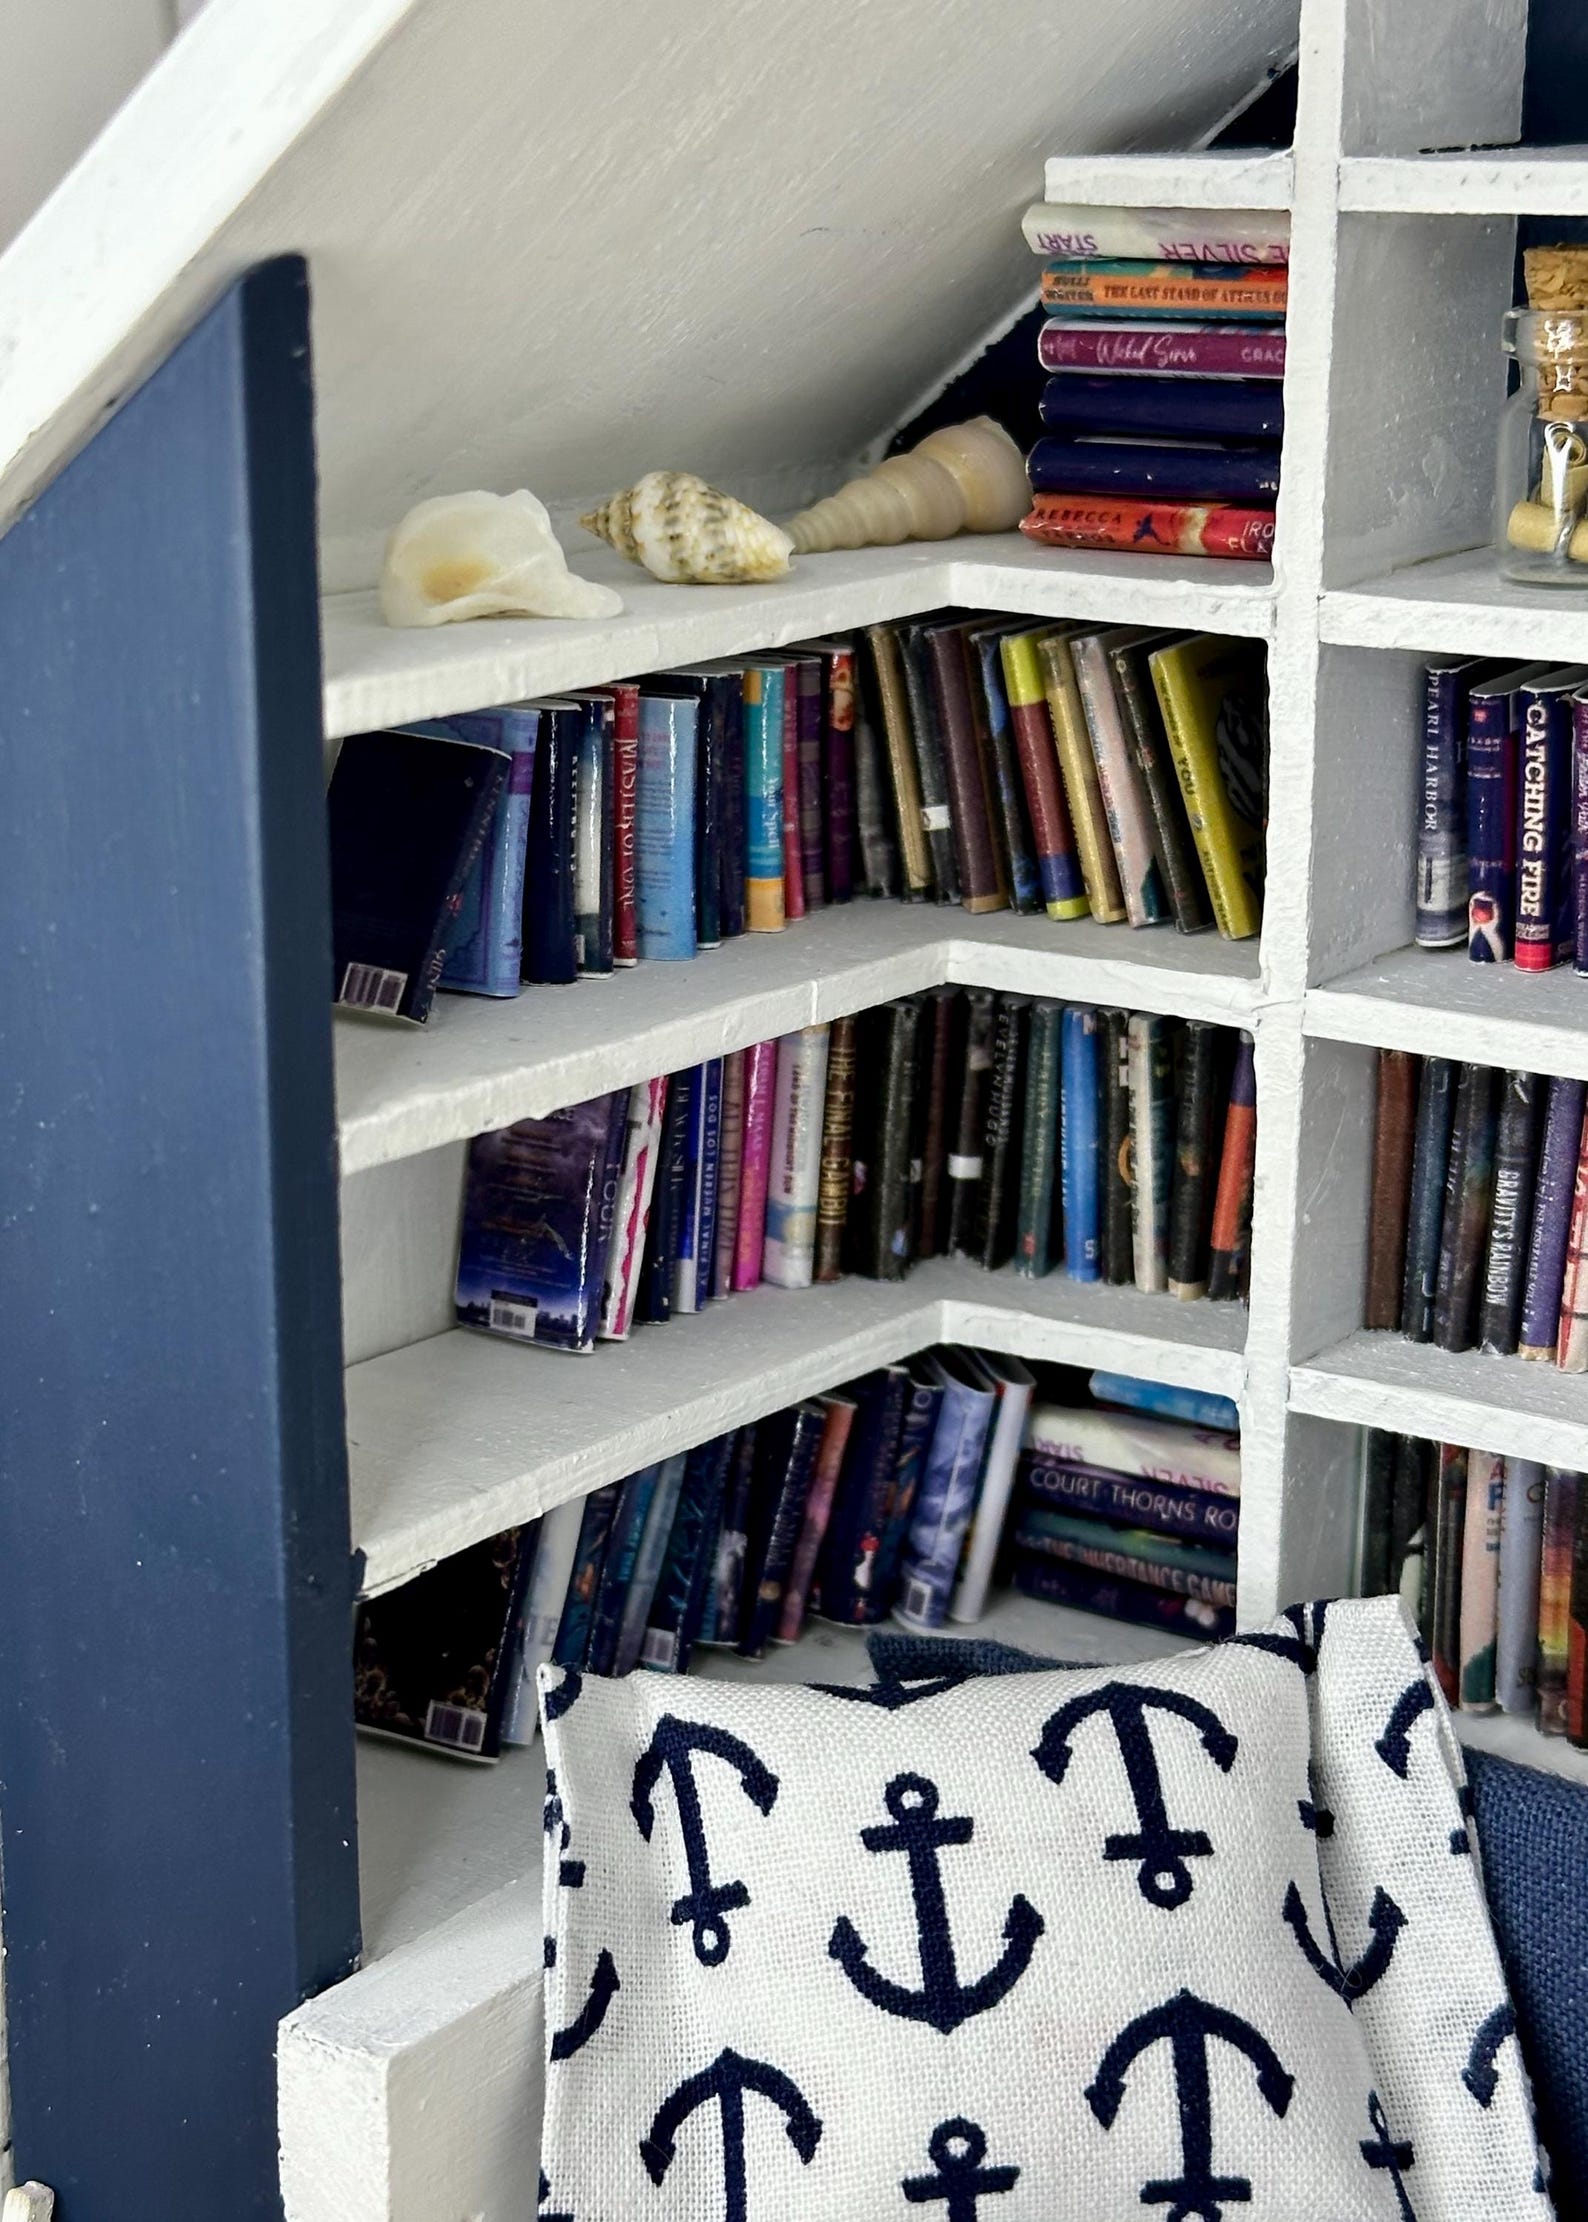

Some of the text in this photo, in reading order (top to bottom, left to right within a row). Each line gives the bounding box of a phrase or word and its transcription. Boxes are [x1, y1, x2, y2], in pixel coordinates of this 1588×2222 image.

[1104, 285, 1129, 299] THE
[1130, 286, 1159, 300] LAST
[1161, 286, 1200, 301] STAND
[1034, 508, 1123, 525] REBECCA
[1174, 756, 1199, 796] YOU
[1424, 675, 1440, 830] PEARL HARBOR
[1522, 704, 1546, 852] CATCHING
[615, 738, 639, 829] MASTER
[767, 812, 781, 848] Spell
[1520, 858, 1544, 917] FIRE
[708, 1094, 719, 1124] DOS
[825, 1090, 856, 1147] FINAL
[985, 1090, 1001, 1147] HUGO
[706, 1129, 717, 1157] LOS
[701, 1223, 712, 1265] FINAL
[1485, 1169, 1521, 1306] GRAVITY'S RAINBOW
[1030, 1467, 1101, 1498] COURT
[1111, 1484, 1196, 1521] THORNS
